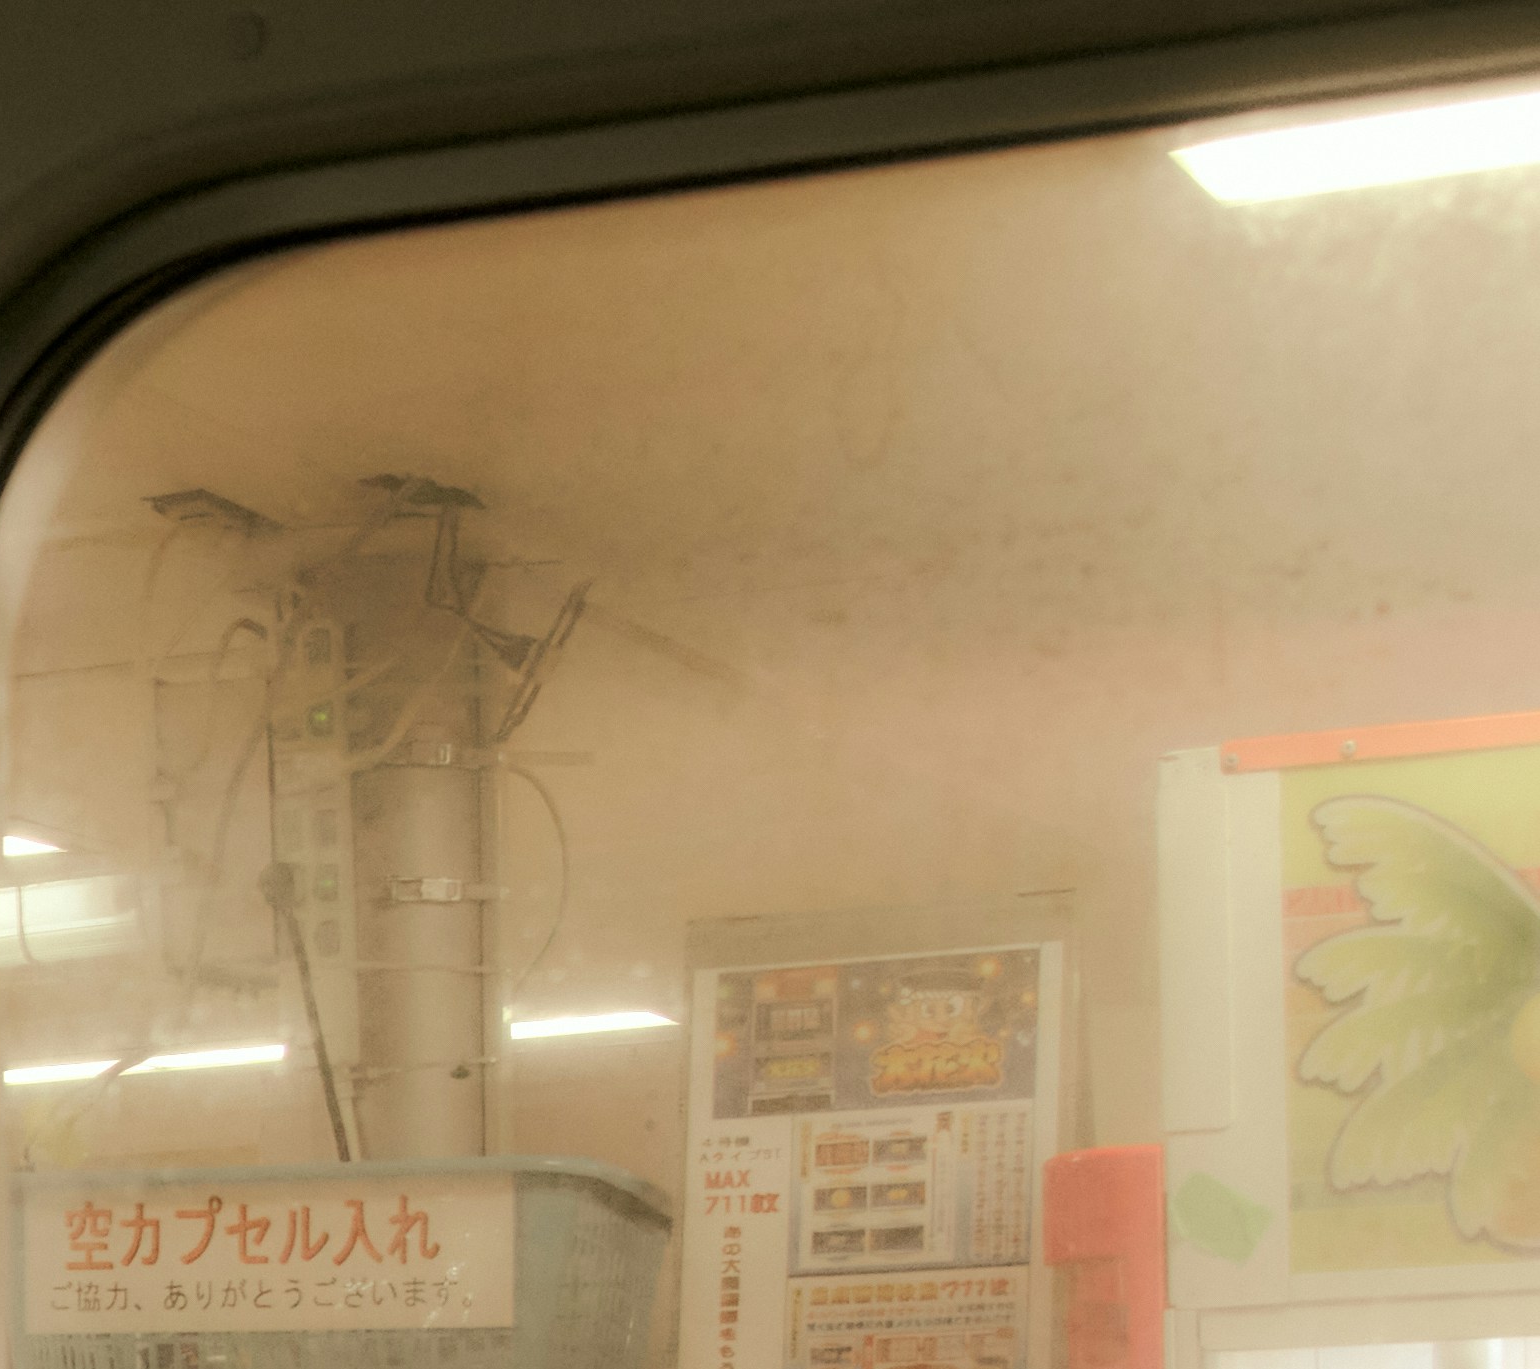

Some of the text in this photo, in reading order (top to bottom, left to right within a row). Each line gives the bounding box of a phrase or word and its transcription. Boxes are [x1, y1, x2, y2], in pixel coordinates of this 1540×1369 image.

[704, 1168, 751, 1190] MAX
[64, 1195, 441, 1271] 空カプセル入れ
[49, 1277, 474, 1312] ご協力、ありがとうございます。
